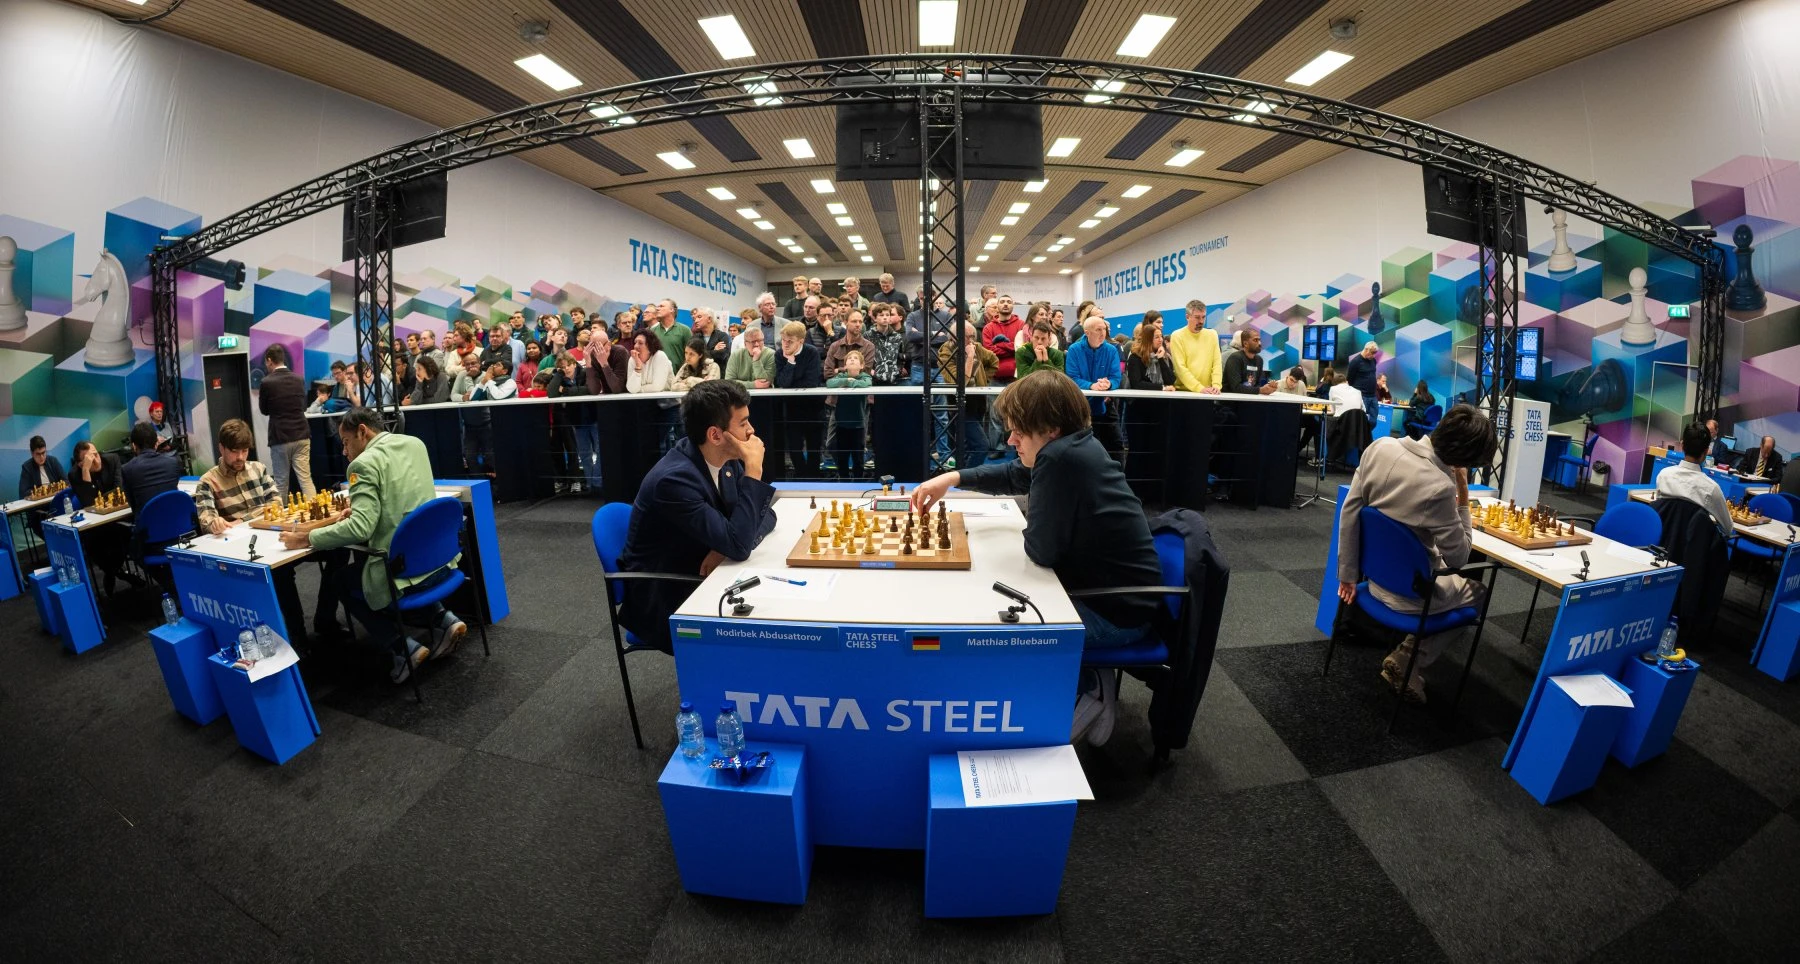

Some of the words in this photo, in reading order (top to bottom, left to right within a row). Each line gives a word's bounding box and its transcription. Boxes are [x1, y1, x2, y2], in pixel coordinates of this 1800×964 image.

[1189, 235, 1229, 257] TOURNAMENT
[629, 238, 669, 279] TATA
[671, 253, 707, 289] STEEL
[708, 266, 737, 297] CHESS
[1094, 275, 1113, 300] TATA
[1114, 265, 1143, 296] STEEL
[1144, 249, 1187, 288] CHESS
[1527, 409, 1542, 420] TATA
[1525, 420, 1543, 431] STEEL
[1524, 431, 1544, 442] CHESS
[188, 592, 226, 622] TATA
[716, 628, 758, 638] Nodirbek
[759, 630, 822, 642] Abdusattorov
[846, 632, 869, 641] TATA
[871, 633, 899, 642] STEEL
[967, 637, 1008, 646] Matthias
[1011, 636, 1058, 646] Bluebaum
[1567, 628, 1614, 661] TATA
[1616, 617, 1655, 648] STEEL
[846, 641, 877, 649] CHESS
[724, 690, 870, 730] TATA
[886, 699, 1024, 732] STEEL
